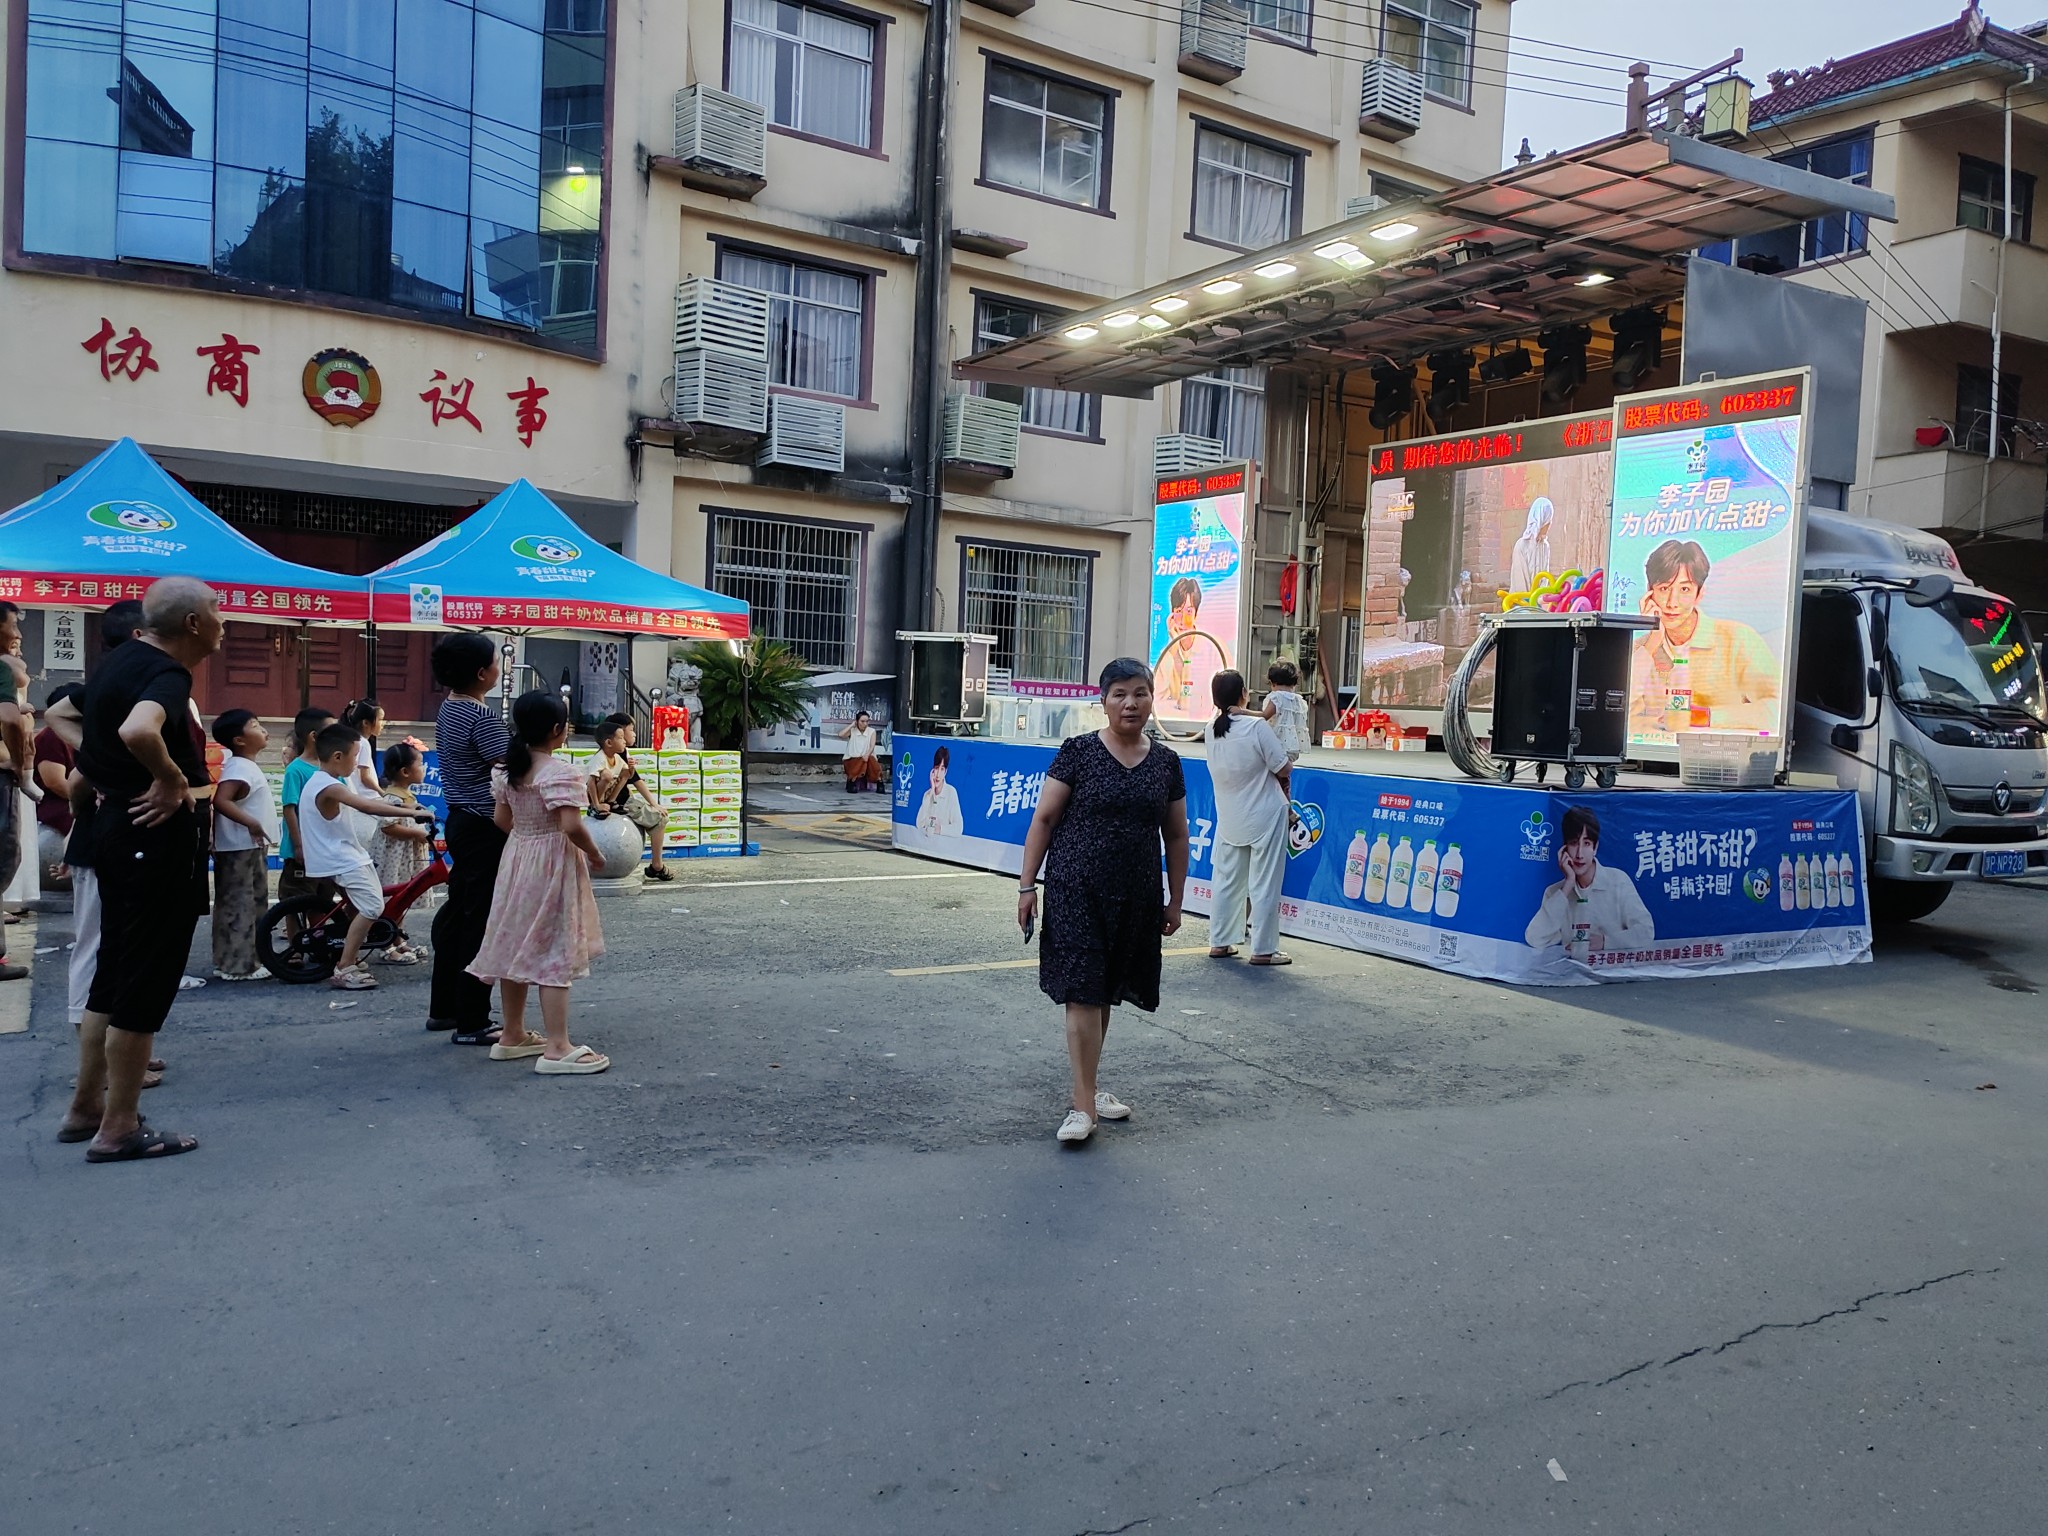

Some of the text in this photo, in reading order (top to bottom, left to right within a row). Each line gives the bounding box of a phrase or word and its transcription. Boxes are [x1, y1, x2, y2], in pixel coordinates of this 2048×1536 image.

[81, 317, 549, 448] 协商 议事
[1404, 433, 1523, 470] 期待您的光临！
[1657, 478, 1731, 509] 李子园
[1176, 535, 1211, 555] 李子园
[446, 611, 483, 619] 605337
[492, 604, 720, 631] 李子园甜牛奶饮品销量全国领先
[53, 610, 76, 660] 合垦殖场
[831, 691, 855, 706] 陪伴
[1415, 799, 1443, 810] 经典口味
[1634, 828, 1757, 880] 青春甜不甜?
[1663, 872, 1733, 900] 喝瓶李子园!
[1588, 943, 1724, 966] 李子园甜牛奶饮品销量全国领先
